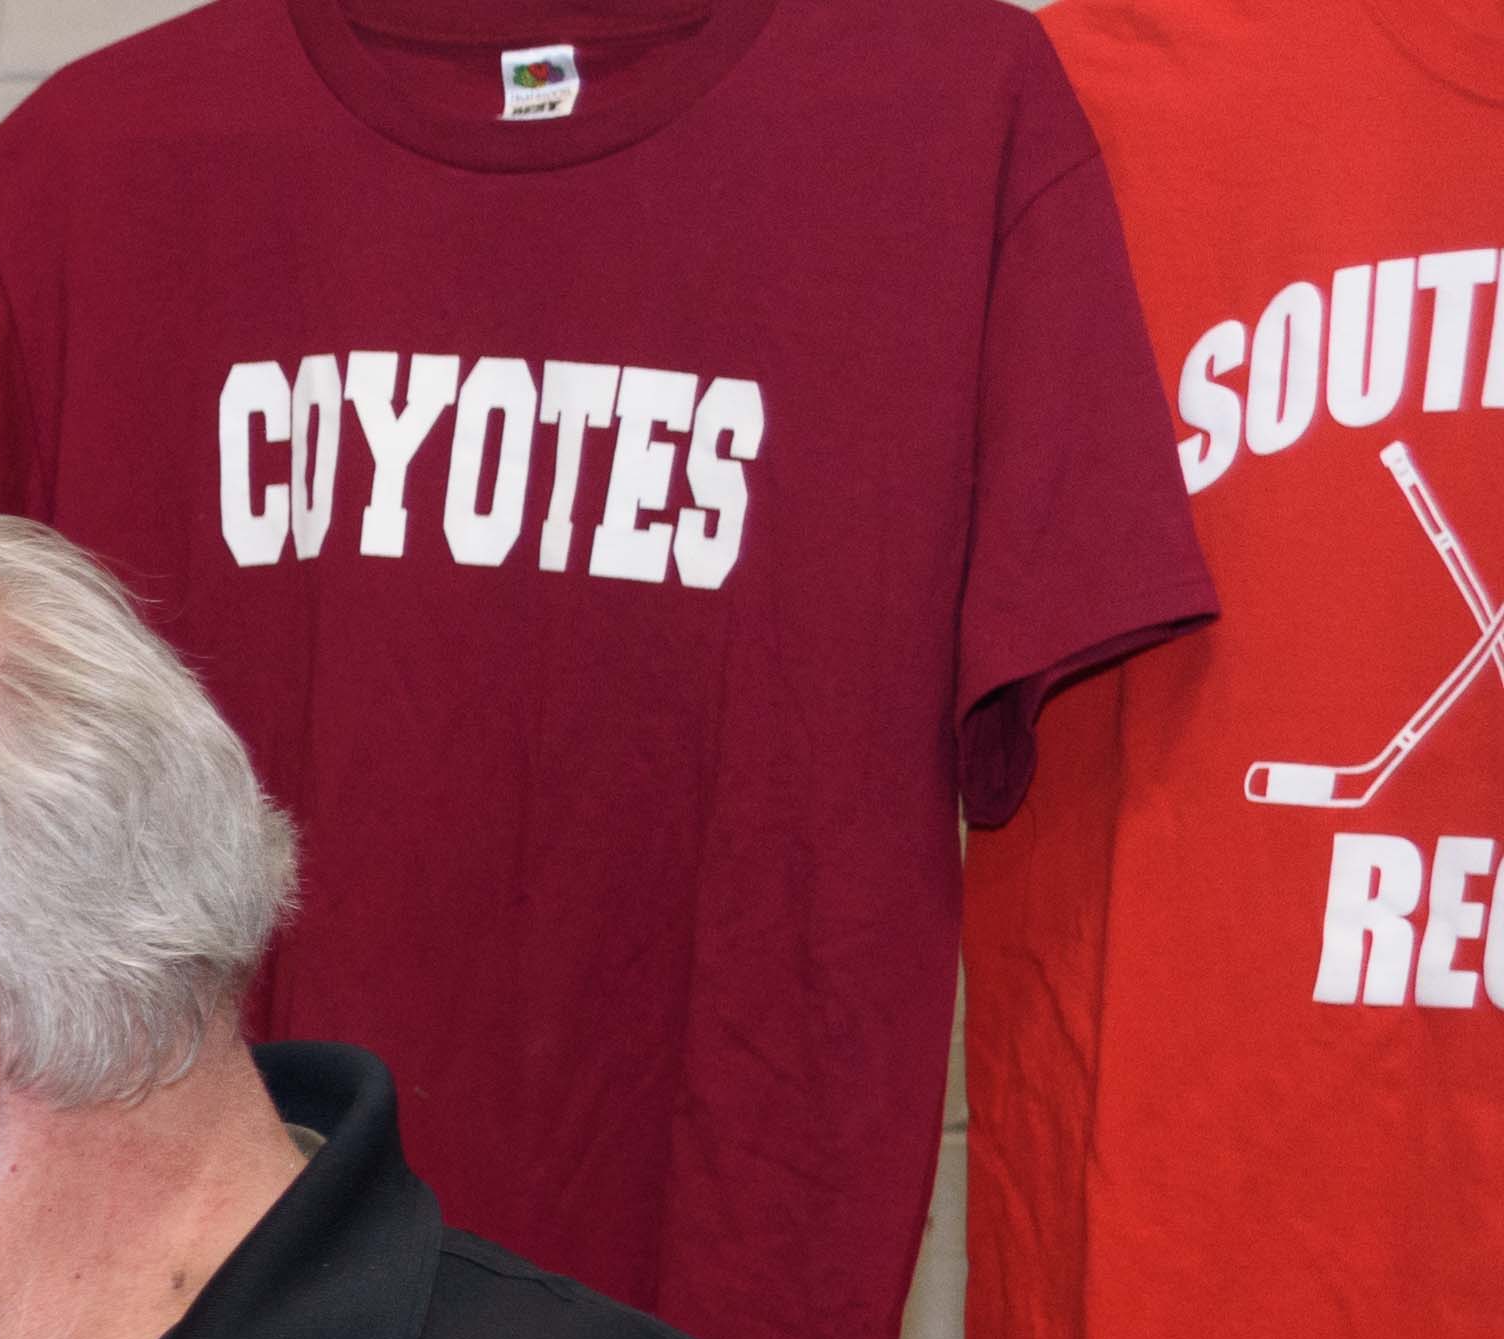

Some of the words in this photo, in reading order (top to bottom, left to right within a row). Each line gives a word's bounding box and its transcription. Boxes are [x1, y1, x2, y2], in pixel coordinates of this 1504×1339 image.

[218, 350, 765, 590] COYOTES
[1176, 247, 1504, 497] SOUT
[1312, 832, 1504, 1010] RE
